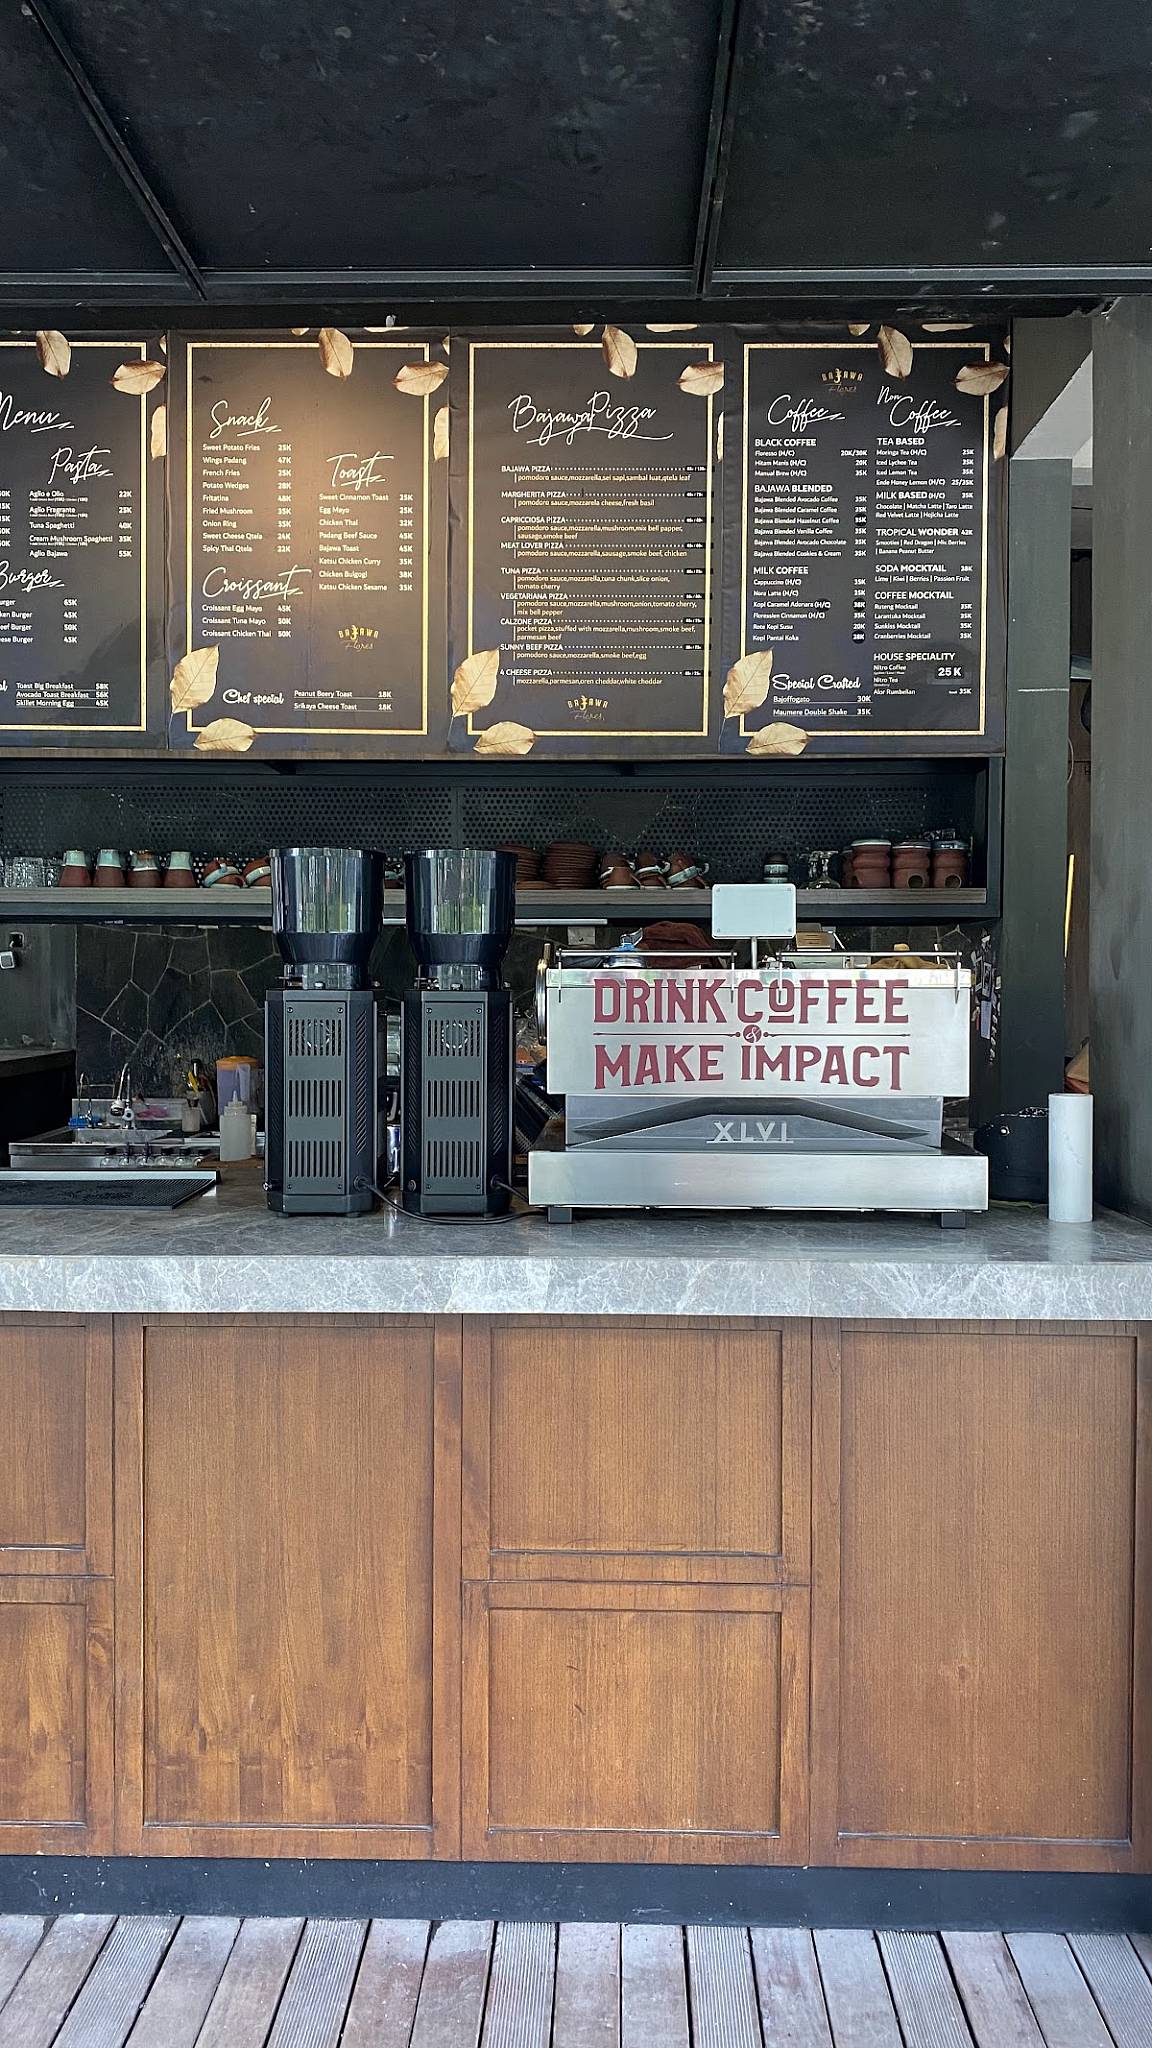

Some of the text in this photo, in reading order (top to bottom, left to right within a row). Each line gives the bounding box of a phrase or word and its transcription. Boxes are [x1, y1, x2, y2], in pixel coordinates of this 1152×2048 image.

[210, 397, 274, 438] Snack
[768, 394, 836, 433] Coffee
[889, 396, 953, 434] Coffee
[508, 391, 656, 446] Bajawa Pizza
[755, 439, 816, 447] BLACK COFFEE
[877, 438, 894, 446] TEA
[48, 446, 111, 484] Pasta
[326, 451, 394, 491] Toast
[755, 485, 833, 493] BAJAWA BLENDED
[876, 491, 928, 500] MILK BASED
[501, 516, 545, 524] CAPRICCIOSA
[45, 522, 75, 530] Spaghetti
[876, 528, 917, 536] TROPICAL
[918, 528, 959, 536] WONDER
[753, 566, 809, 575] MILK COFFEE
[875, 565, 899, 573] SODA
[900, 564, 947, 572] MOCKTAIL
[202, 565, 311, 600] Croissant
[875, 591, 954, 600] COFFEE MOCKTAIL
[11, 611, 33, 619] Burger
[12, 636, 33, 644] Burger
[526, 643, 543, 651] BEEF
[873, 653, 956, 661] HOUSE SPECIALITY
[938, 667, 952, 676] 25
[772, 674, 861, 691] Special Crafted
[222, 689, 285, 705] Chef special
[294, 689, 316, 697] Peanut
[593, 978, 726, 1024] DRINK
[594, 1045, 910, 1091] MAKE IMPACT
[712, 1122, 788, 1143] XLVI
